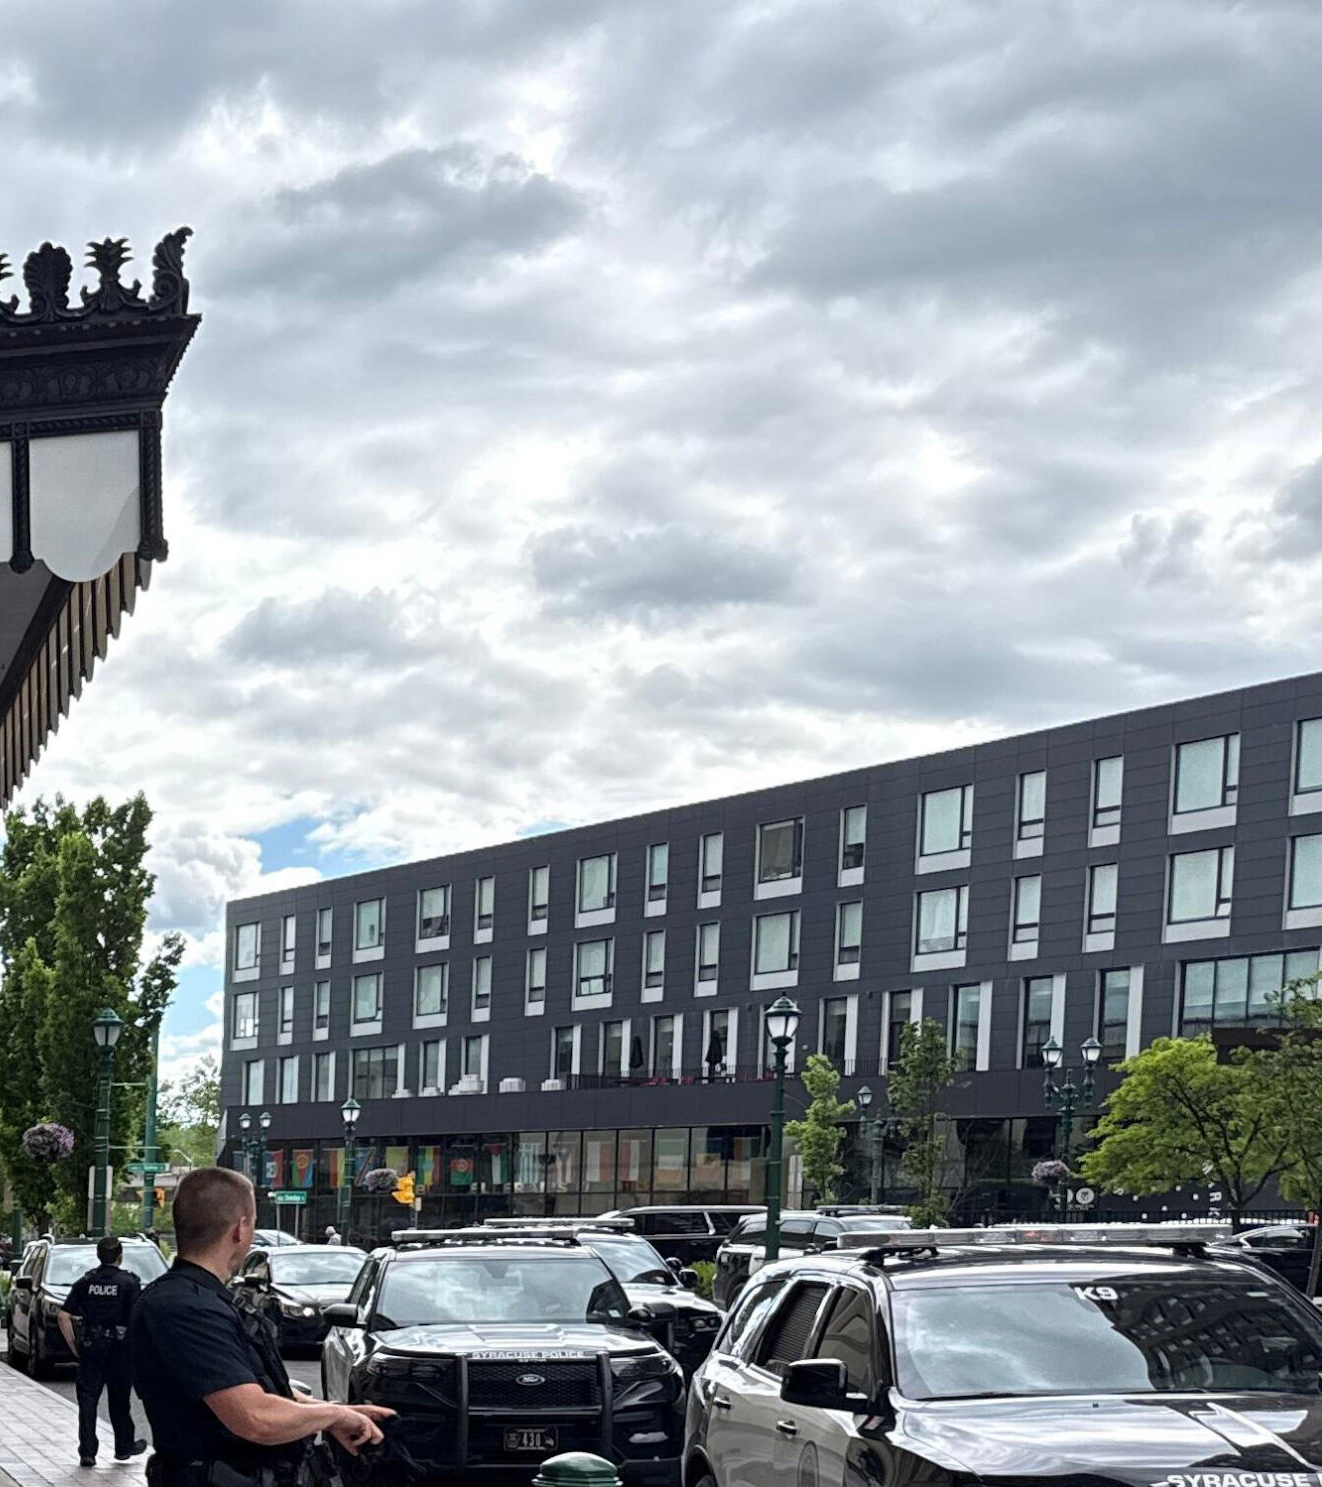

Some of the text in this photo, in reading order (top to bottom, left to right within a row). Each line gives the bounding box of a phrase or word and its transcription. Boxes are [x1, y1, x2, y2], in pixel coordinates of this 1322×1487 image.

[89, 1284, 118, 1296] POLICE
[1073, 1287, 1118, 1300] K9
[472, 1350, 584, 1359] SYRACUSE POLICE
